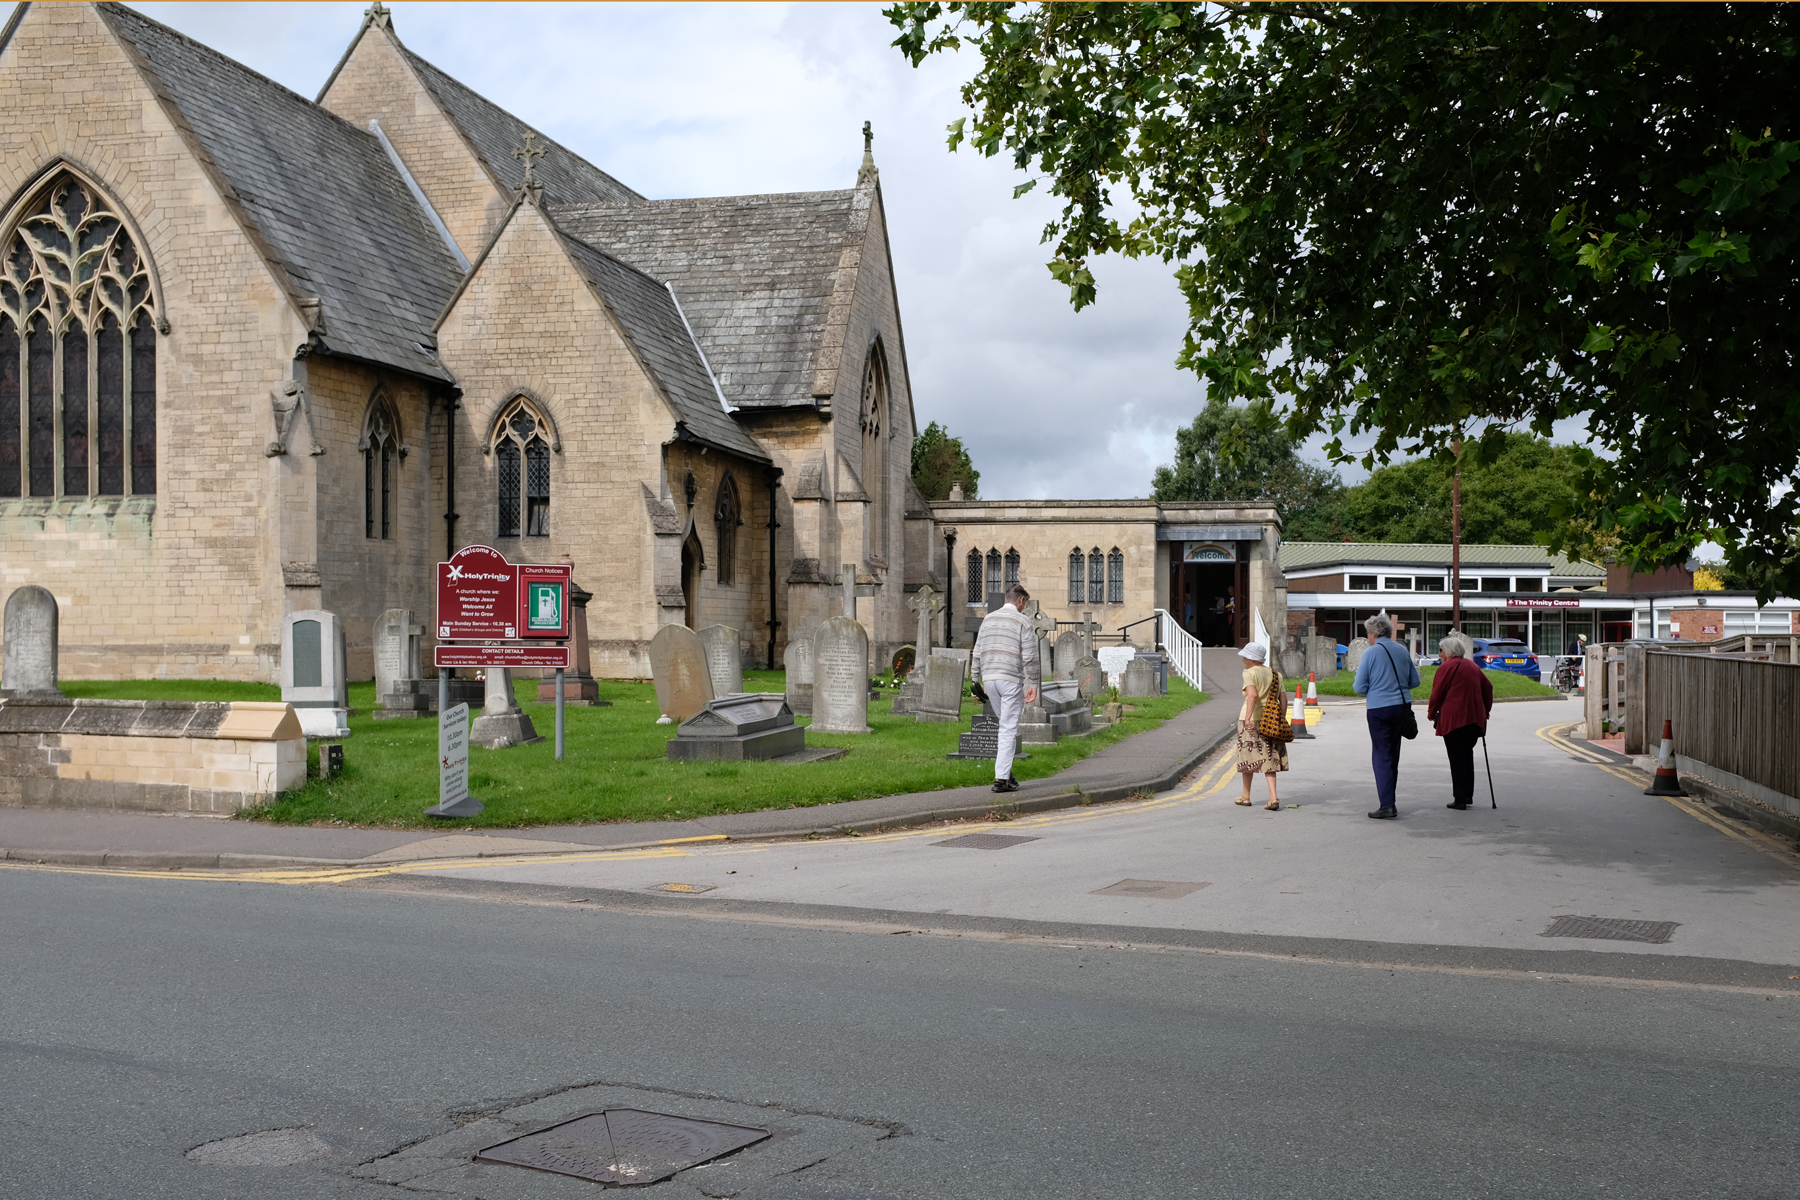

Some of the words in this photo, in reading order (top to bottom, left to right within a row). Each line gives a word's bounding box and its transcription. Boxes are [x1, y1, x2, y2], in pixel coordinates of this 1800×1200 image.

[460, 547, 489, 557] Welcome
[1191, 551, 1230, 559] Welcome
[453, 708, 464, 718] Church
[443, 720, 456, 729] Services
